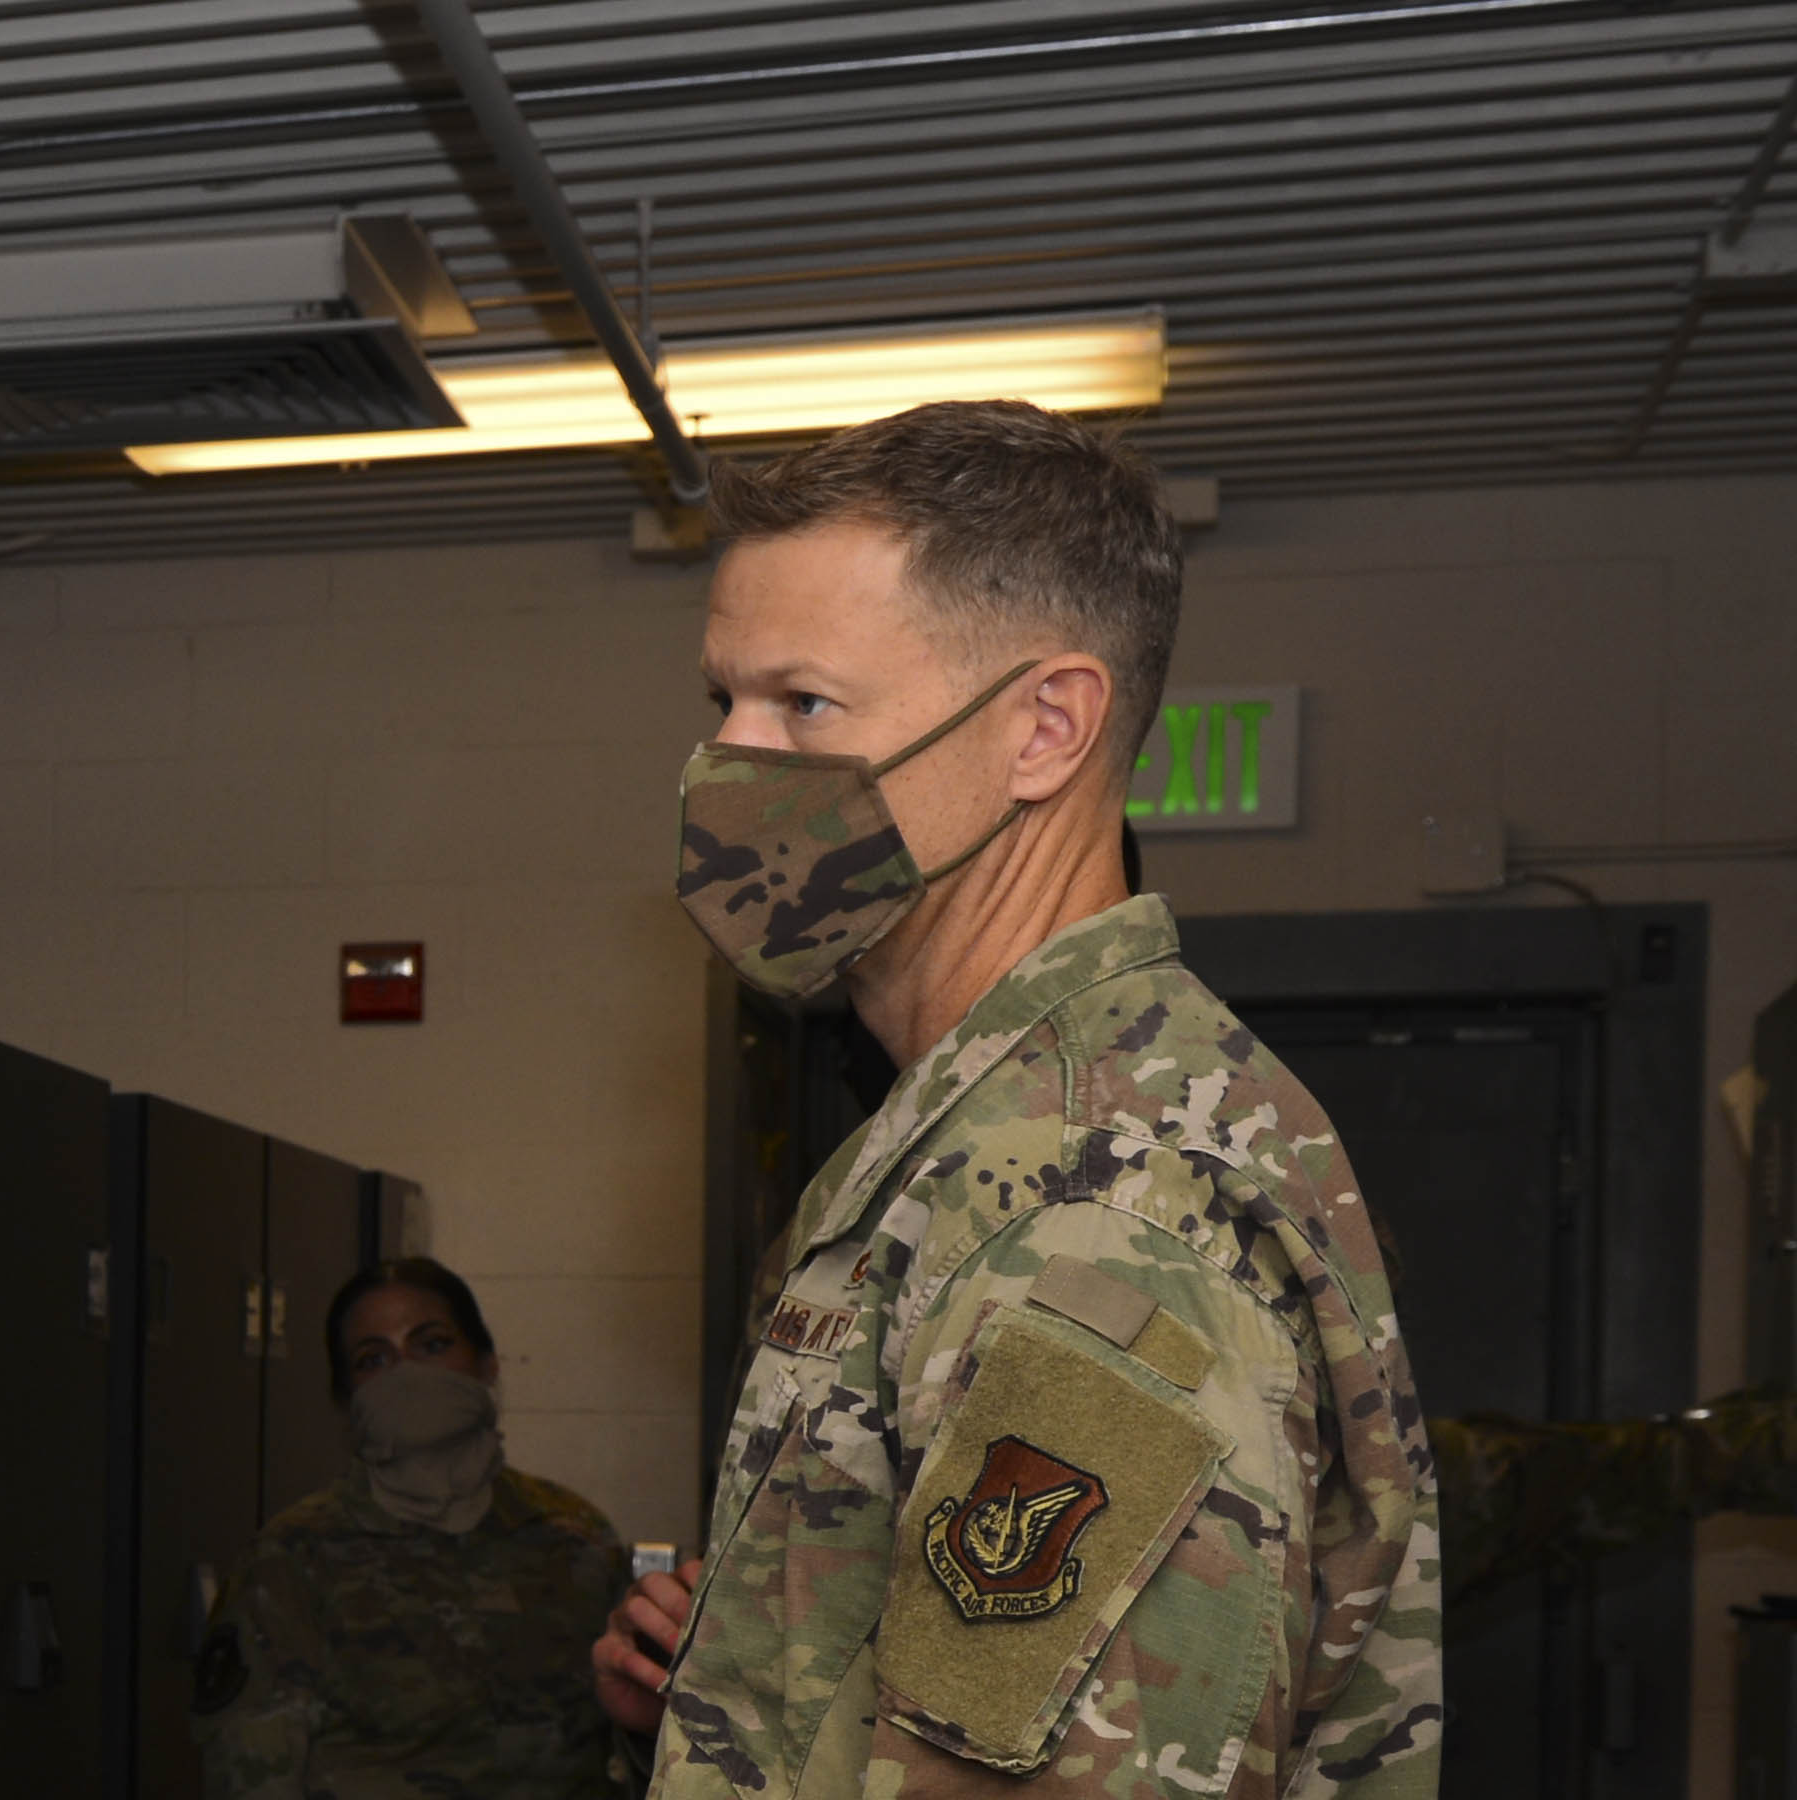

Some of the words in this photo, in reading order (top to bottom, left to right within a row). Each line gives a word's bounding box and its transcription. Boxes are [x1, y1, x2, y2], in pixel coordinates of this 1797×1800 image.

[931, 1539, 967, 1595] PACIFIC
[960, 1593, 988, 1613] AIR
[990, 1592, 1053, 1614] FORCES
